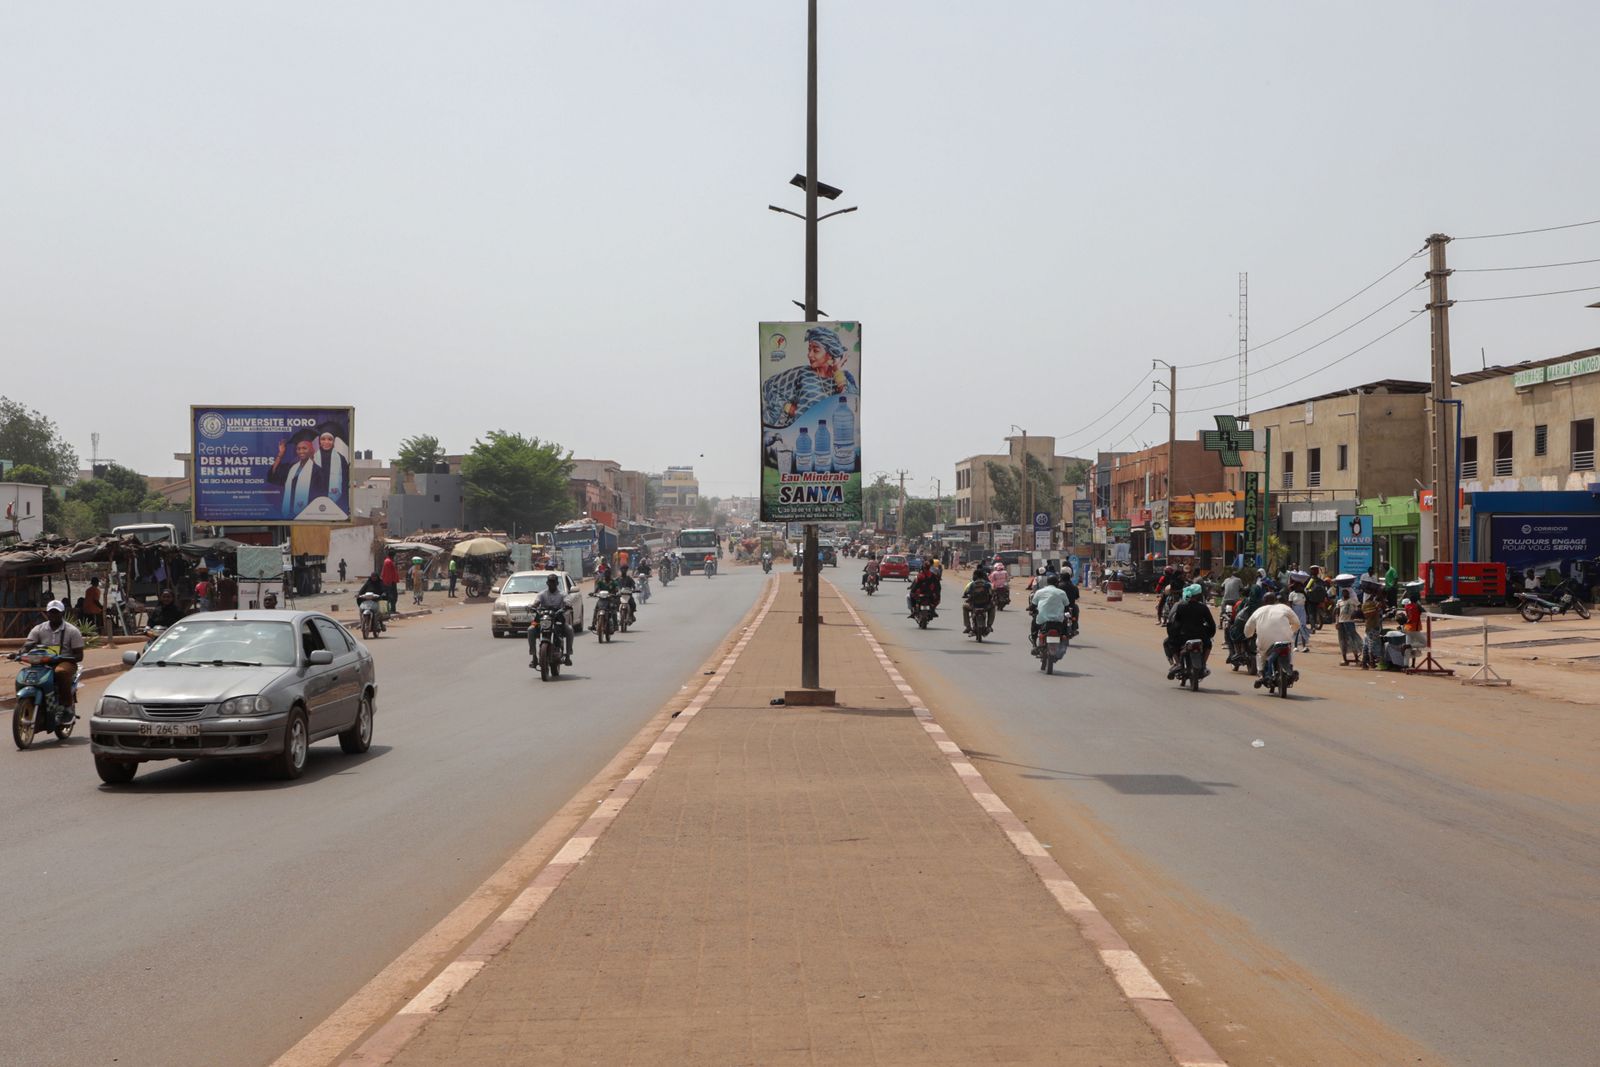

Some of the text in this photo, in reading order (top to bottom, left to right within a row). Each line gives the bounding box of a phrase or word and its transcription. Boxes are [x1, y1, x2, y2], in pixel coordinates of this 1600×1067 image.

[1548, 363, 1571, 379] MARIAM
[1573, 356, 1599, 374] SANOGO
[227, 418, 316, 427] UNIVERSITE KORO
[198, 442, 248, 455] Rentrée
[200, 456, 275, 466] DES MASTERS
[201, 467, 251, 476] EN SANTE
[781, 472, 850, 482] Eau Minérale
[780, 485, 843, 503] SANYA
[1246, 472, 1257, 550] PHARMACIE
[140, 724, 152, 735] BH
[156, 724, 179, 735] 2645
